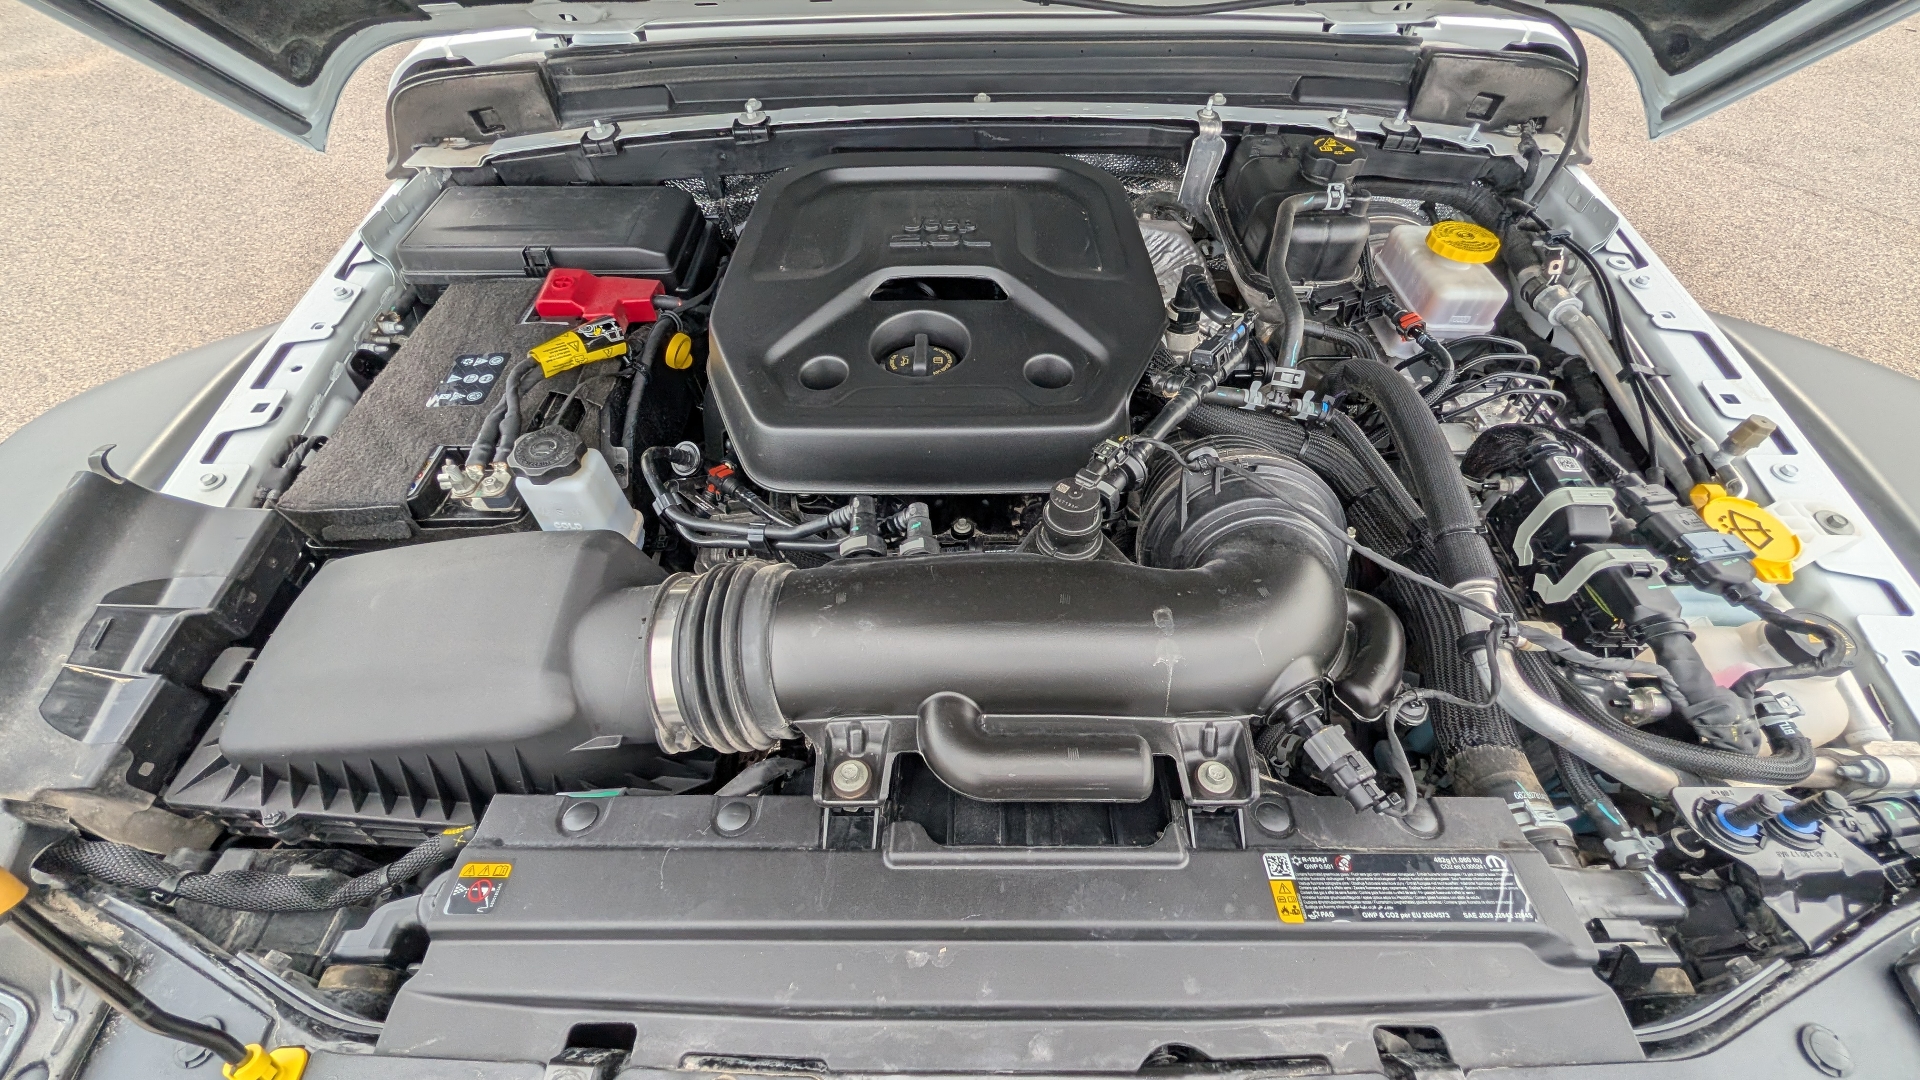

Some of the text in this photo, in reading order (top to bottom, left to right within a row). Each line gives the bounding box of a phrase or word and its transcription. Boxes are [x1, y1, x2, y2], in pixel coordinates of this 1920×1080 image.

[553, 521, 583, 531] COLD
[1361, 911, 1378, 919] GWP
[1385, 911, 1400, 919] CO2
[1411, 911, 1421, 919] EU
[1462, 911, 1478, 919] SAE
